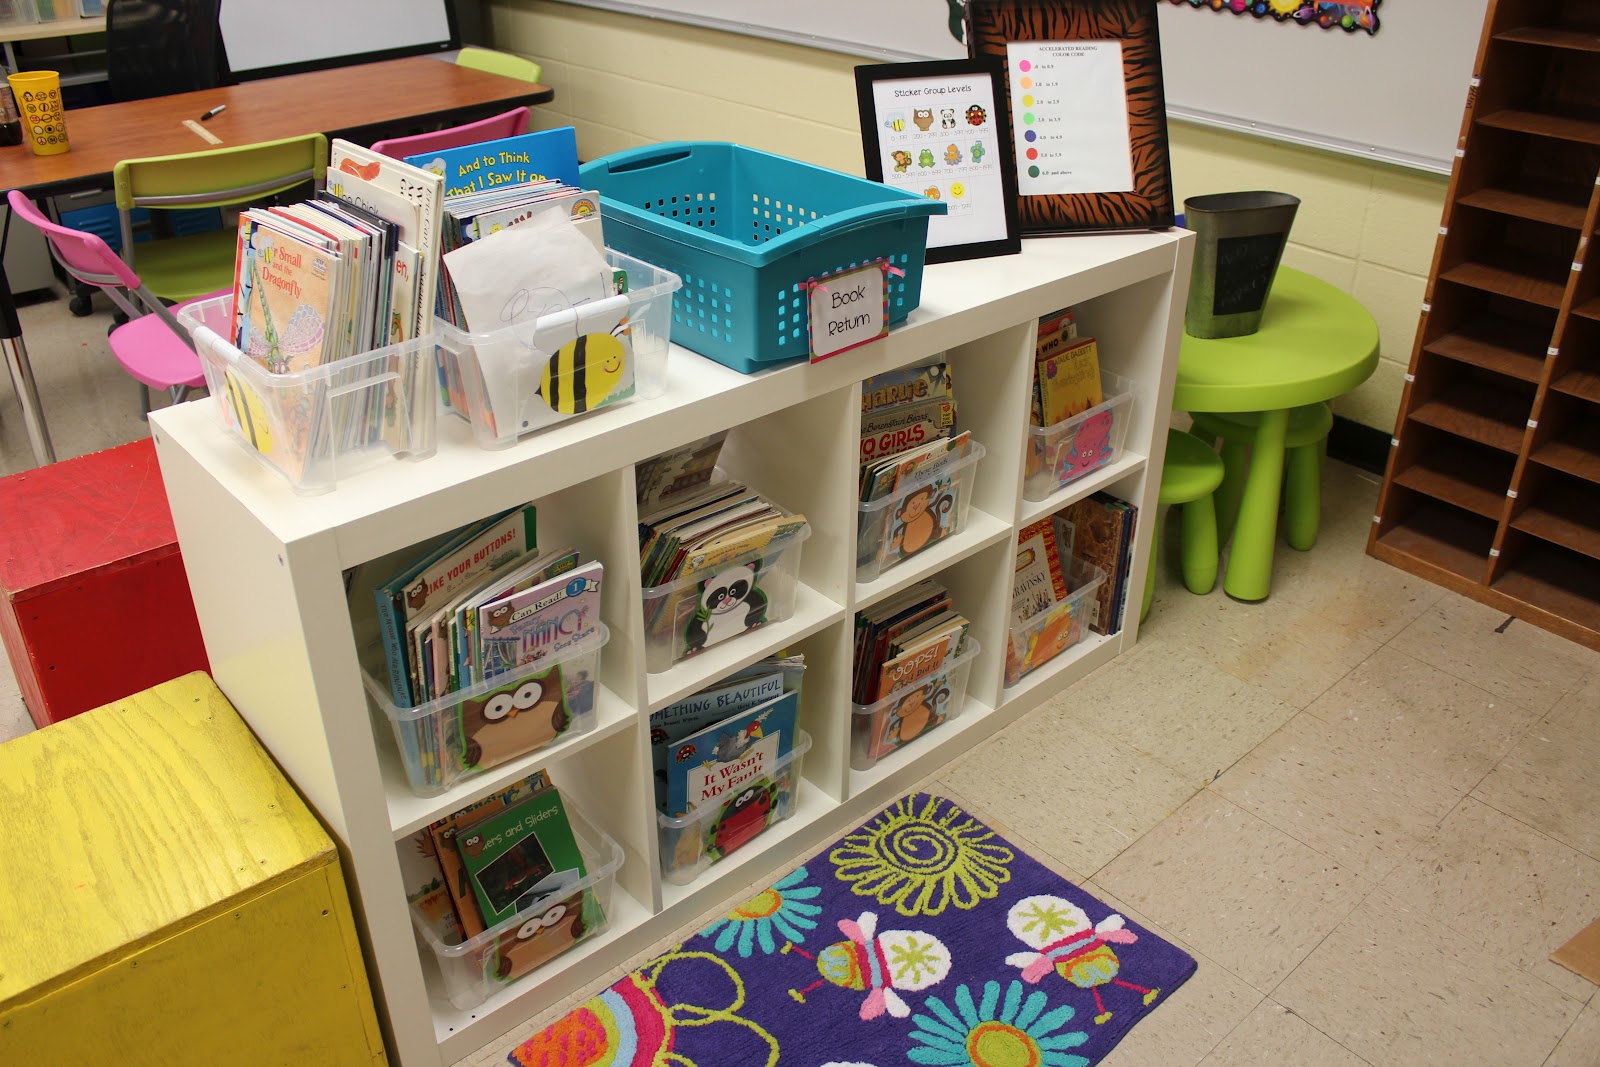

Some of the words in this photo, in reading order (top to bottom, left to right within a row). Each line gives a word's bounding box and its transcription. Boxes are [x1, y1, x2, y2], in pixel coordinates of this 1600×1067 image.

[894, 88, 922, 97] Sticker
[924, 86, 946, 95] Group
[948, 84, 971, 93] Levels
[459, 158, 480, 177] And
[483, 156, 496, 167] to
[499, 152, 530, 164] Think
[478, 177, 484, 188] I
[488, 172, 513, 187] Saw
[516, 170, 526, 182] It
[272, 262, 282, 271] and
[284, 266, 292, 276] the
[280, 246, 302, 268] Small
[262, 266, 302, 299] Dragonfly
[832, 285, 866, 309] Book
[828, 313, 871, 336] Return
[1042, 338, 1058, 353] WHO
[906, 413, 928, 424] Bears
[879, 424, 925, 451] GIRLS
[447, 558, 471, 581] YOUR
[474, 528, 516, 564] BUTTONS!
[512, 609, 532, 621] Can
[534, 592, 562, 611] Read!
[573, 582, 578, 591] 1
[523, 604, 589, 653] NANCY
[716, 679, 780, 708] BEAUTIFUL
[704, 774, 716, 786] It
[719, 752, 764, 779] Wasn't
[701, 784, 725, 801] My
[505, 820, 524, 838] and
[525, 805, 558, 828] Sliders
